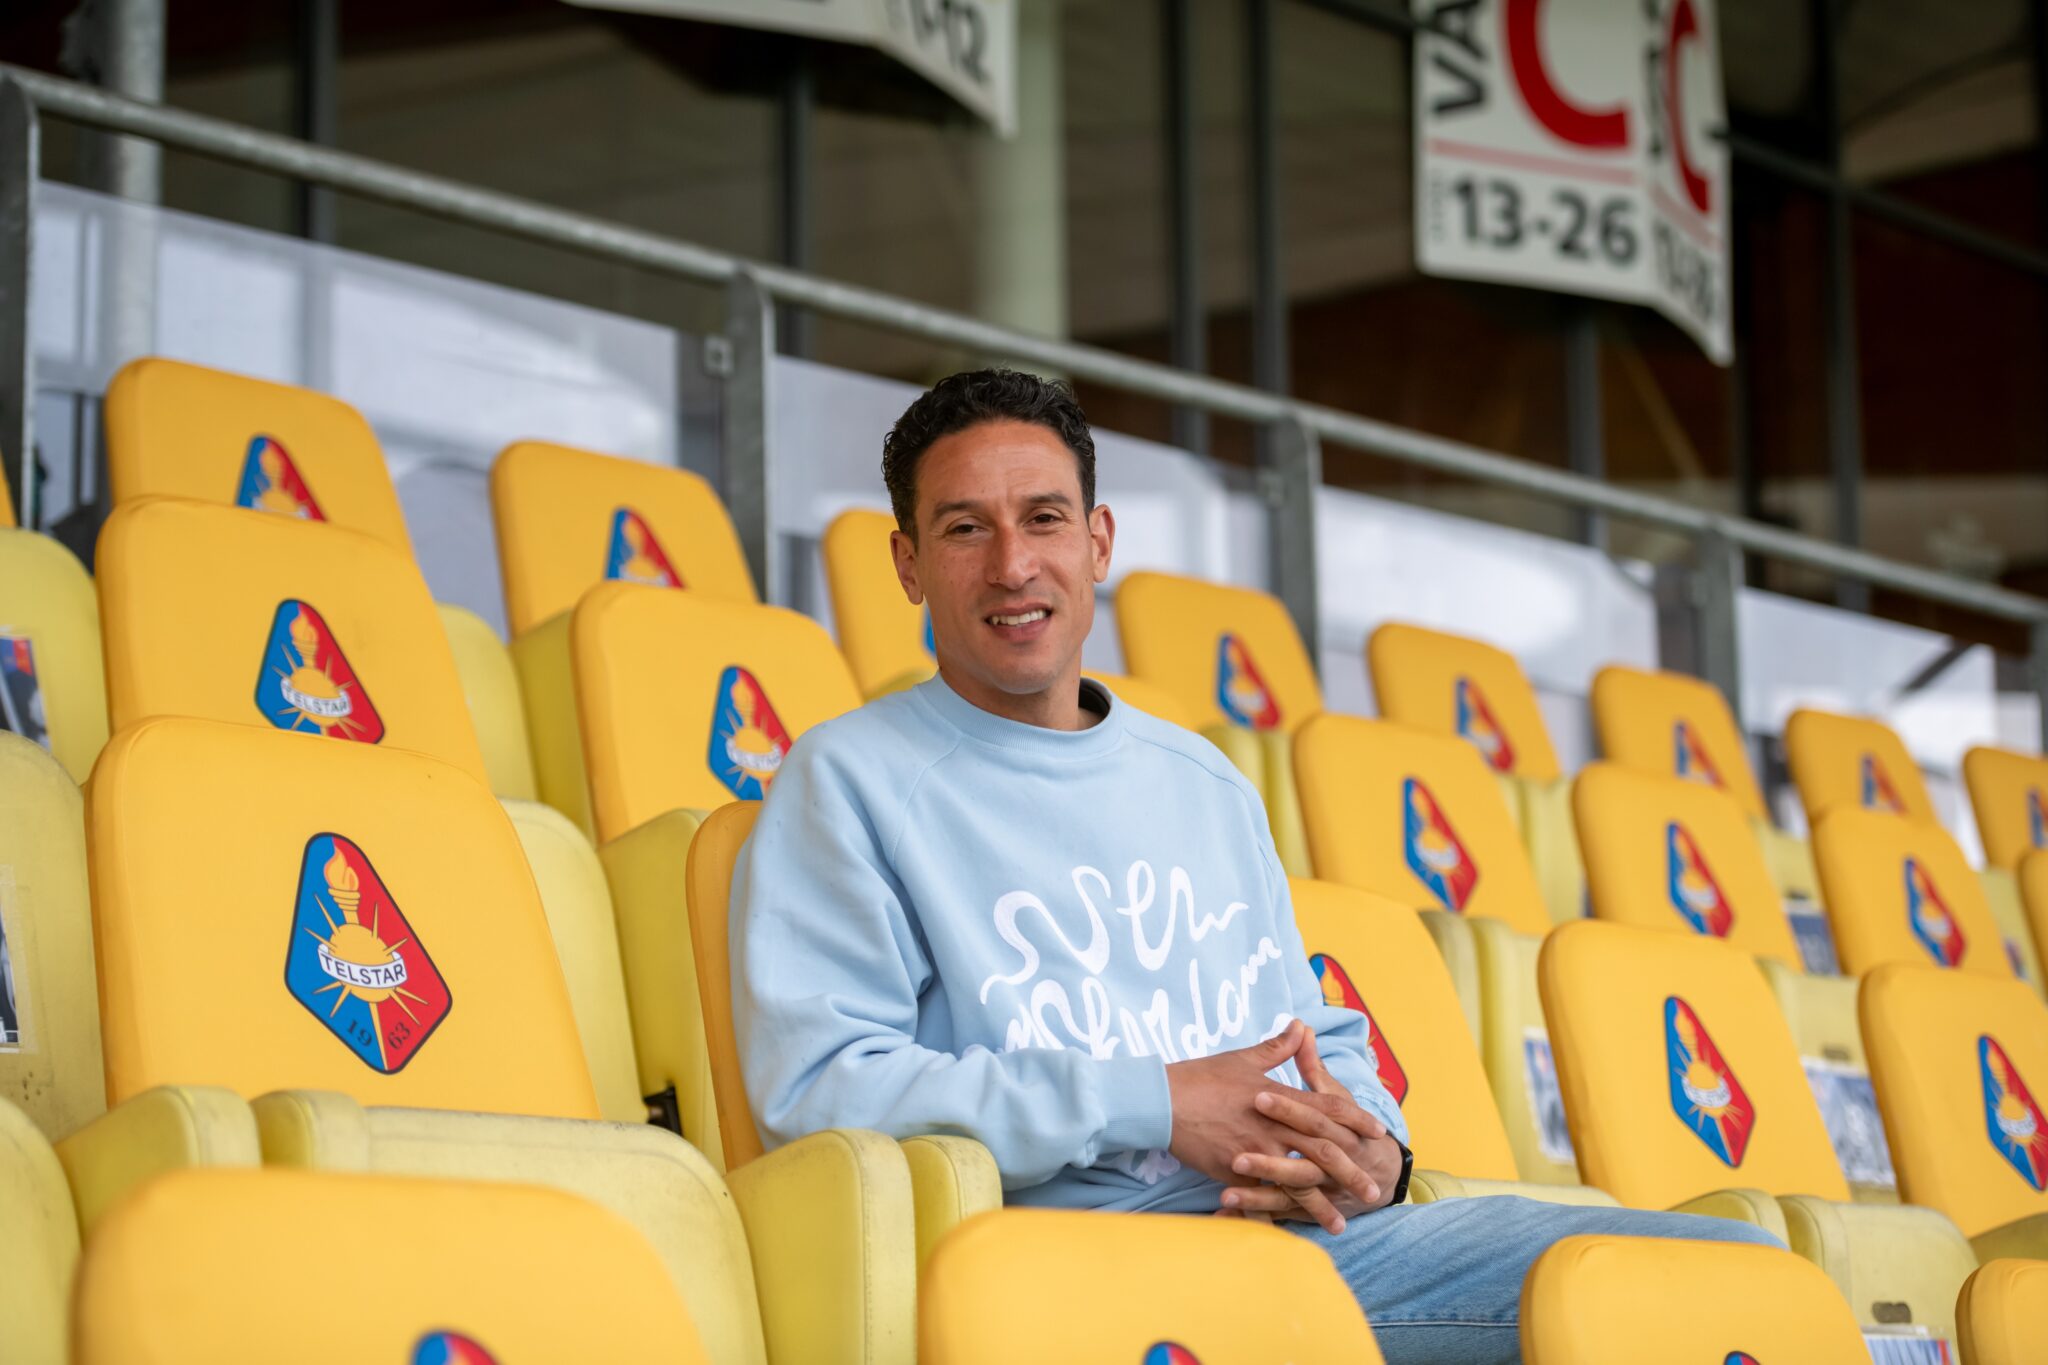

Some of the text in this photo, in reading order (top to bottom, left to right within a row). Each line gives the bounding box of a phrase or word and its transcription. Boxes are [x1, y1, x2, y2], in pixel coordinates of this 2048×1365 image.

[1455, 177, 1639, 268] 13-26
[285, 685, 348, 715] TELSTAR
[320, 952, 406, 986] TELSTAR
